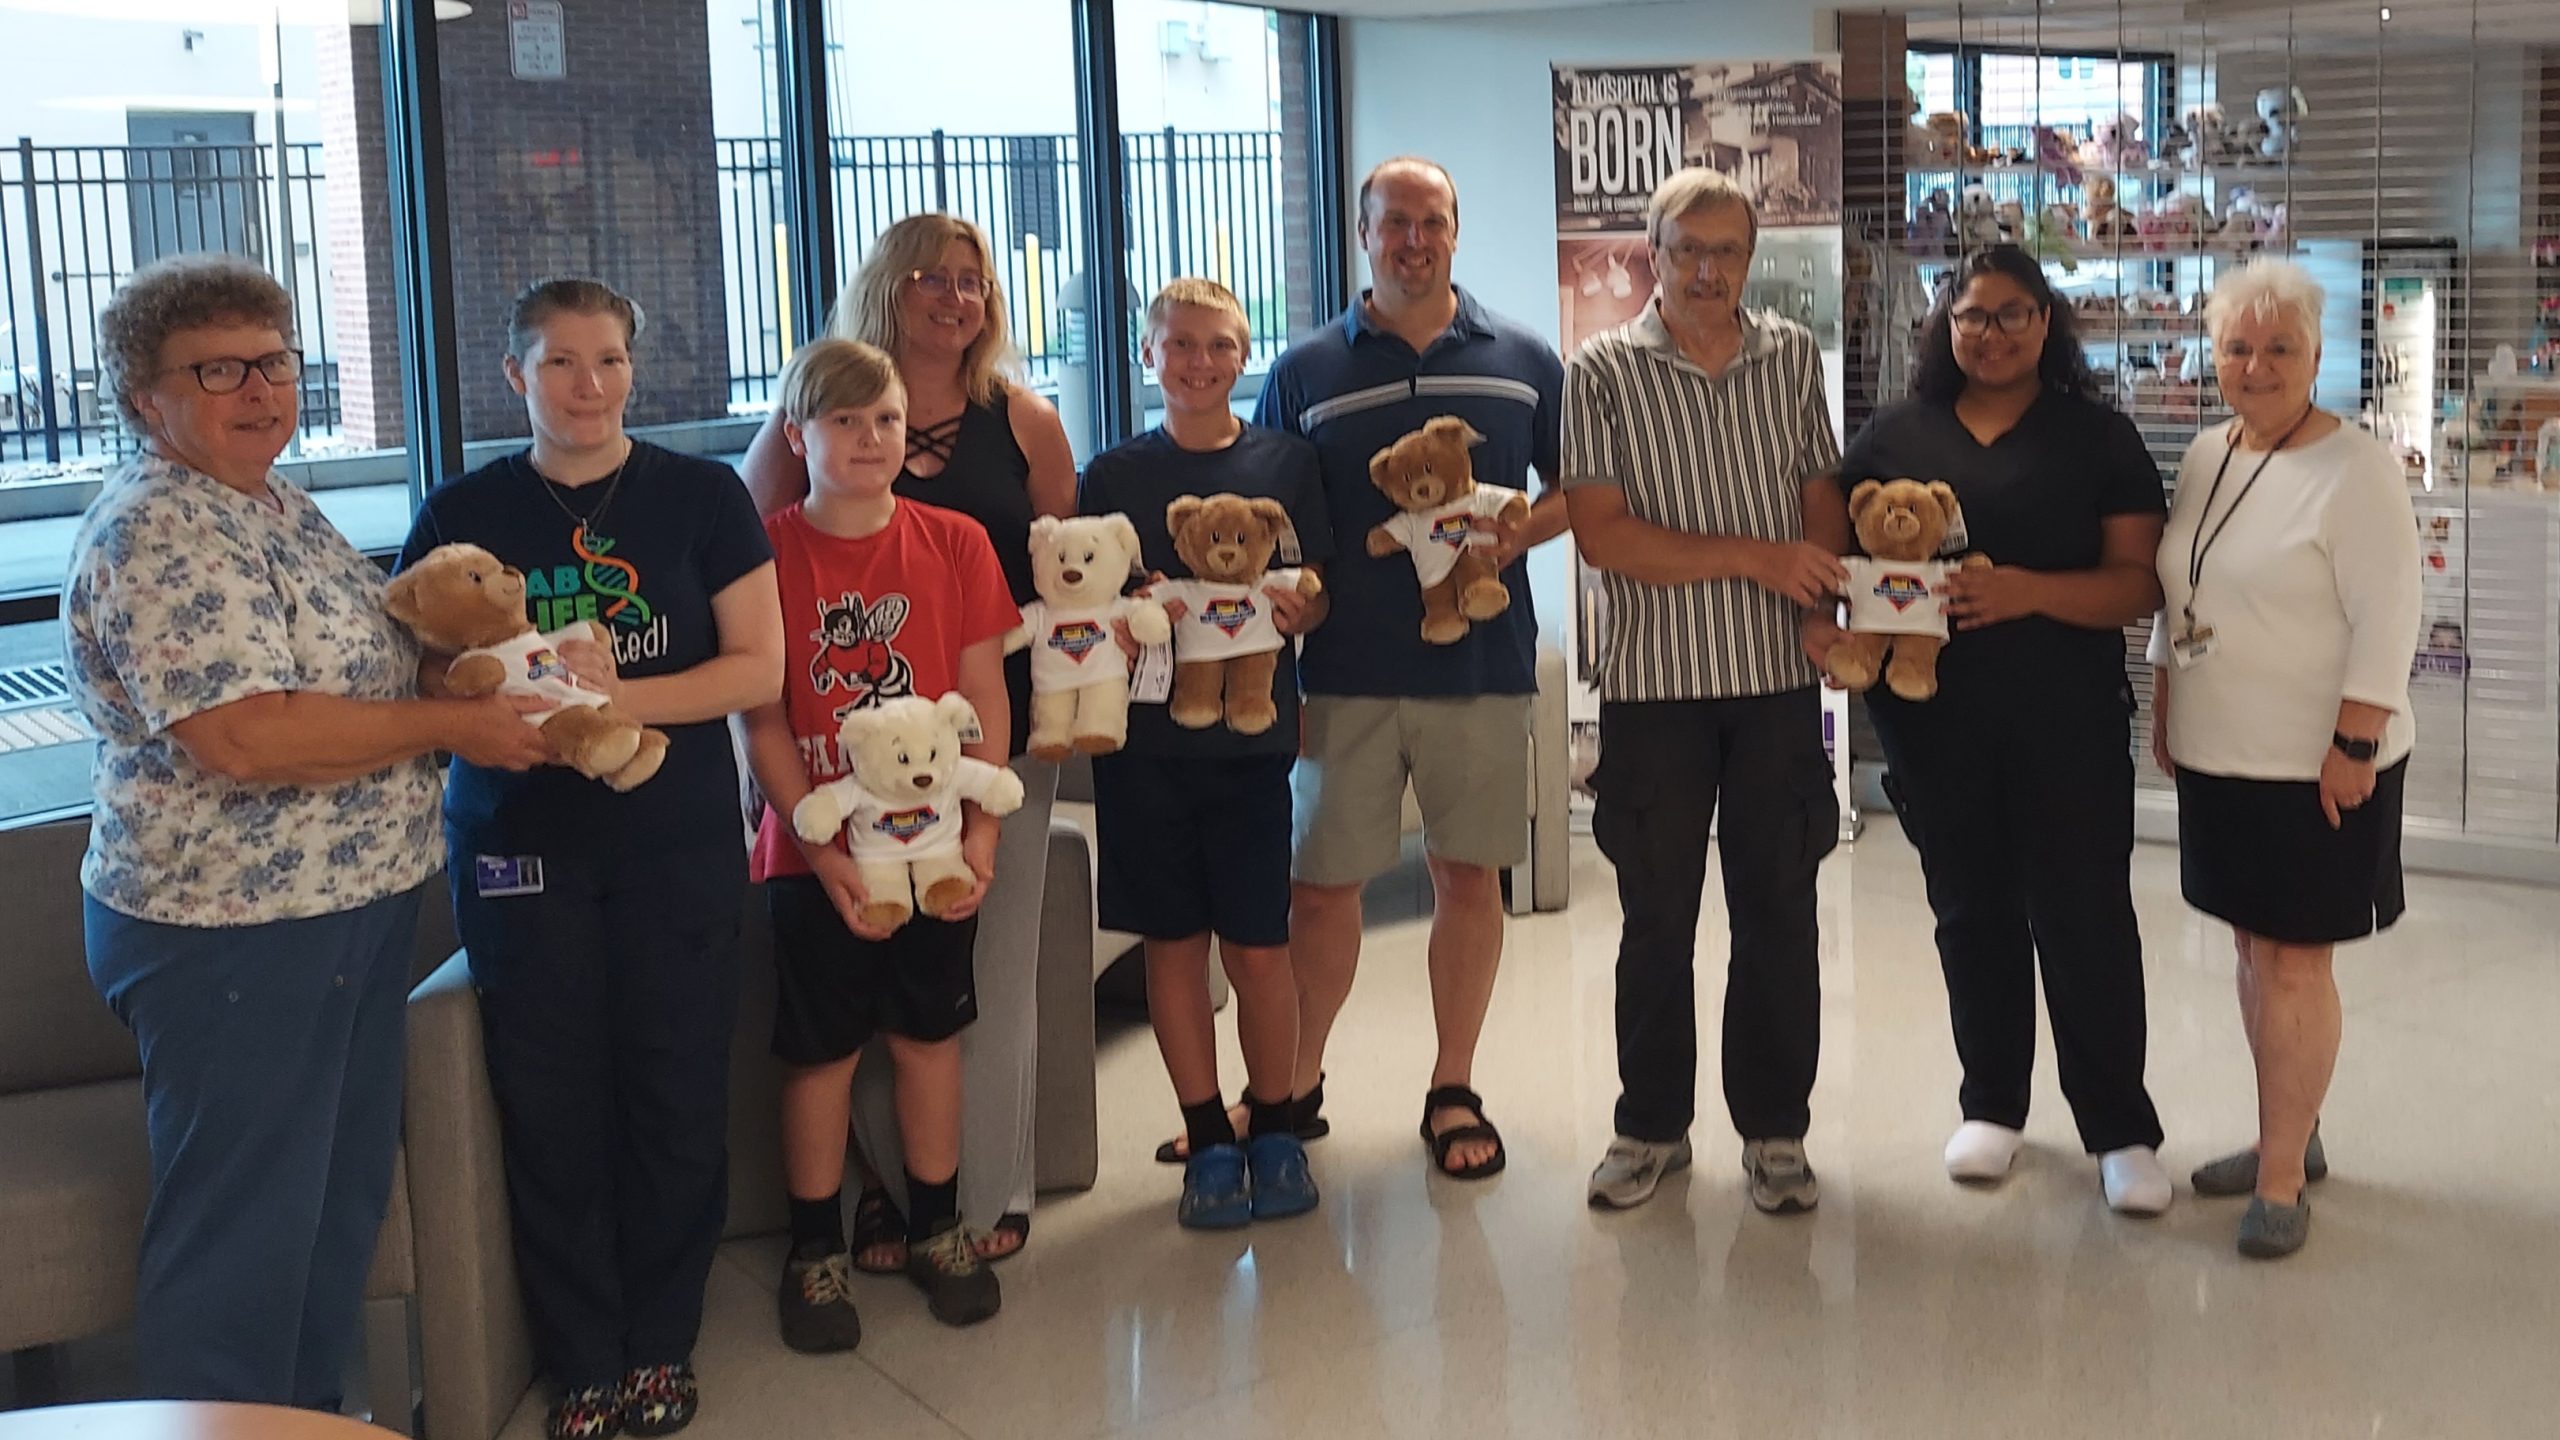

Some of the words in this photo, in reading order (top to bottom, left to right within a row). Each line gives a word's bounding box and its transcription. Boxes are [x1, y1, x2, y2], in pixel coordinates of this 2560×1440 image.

[1572, 75, 1583, 106] A
[1586, 73, 1660, 105] HOSPITAL
[1662, 72, 1679, 104] IS
[1570, 105, 1682, 195] BORN
[526, 566, 581, 599] AB
[536, 594, 597, 634] IFE
[610, 614, 668, 665] ted!
